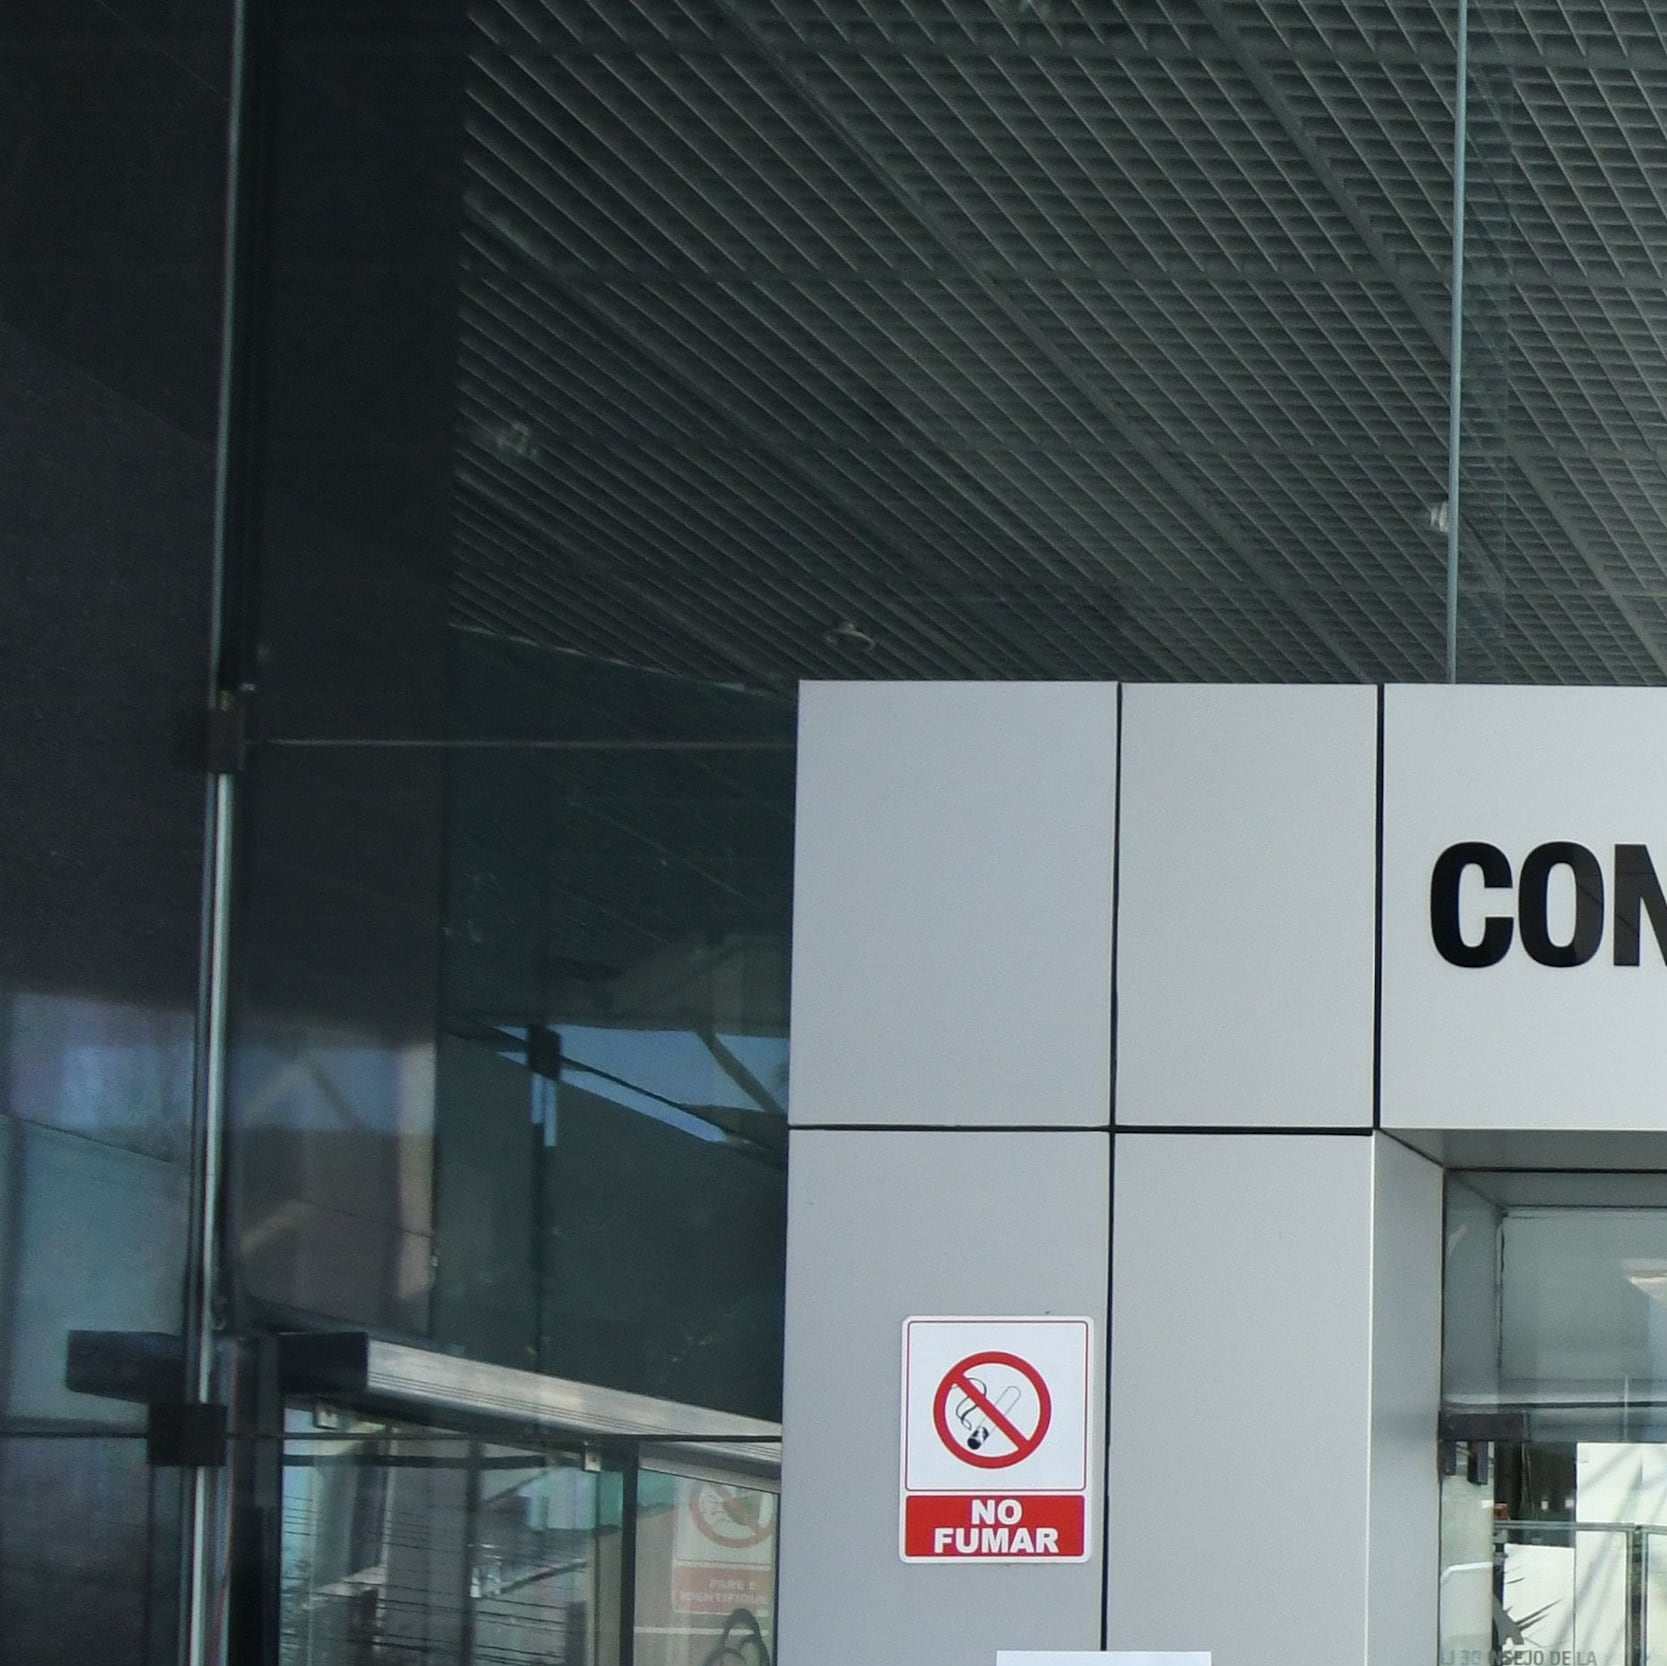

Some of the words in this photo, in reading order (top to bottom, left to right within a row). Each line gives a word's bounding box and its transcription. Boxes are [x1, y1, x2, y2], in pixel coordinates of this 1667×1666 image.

[971, 1499, 1023, 1525] NO
[934, 1527, 1060, 1554] FUMAR
[1550, 1650, 1570, 1666] DE
[1577, 1650, 1598, 1666] LA
